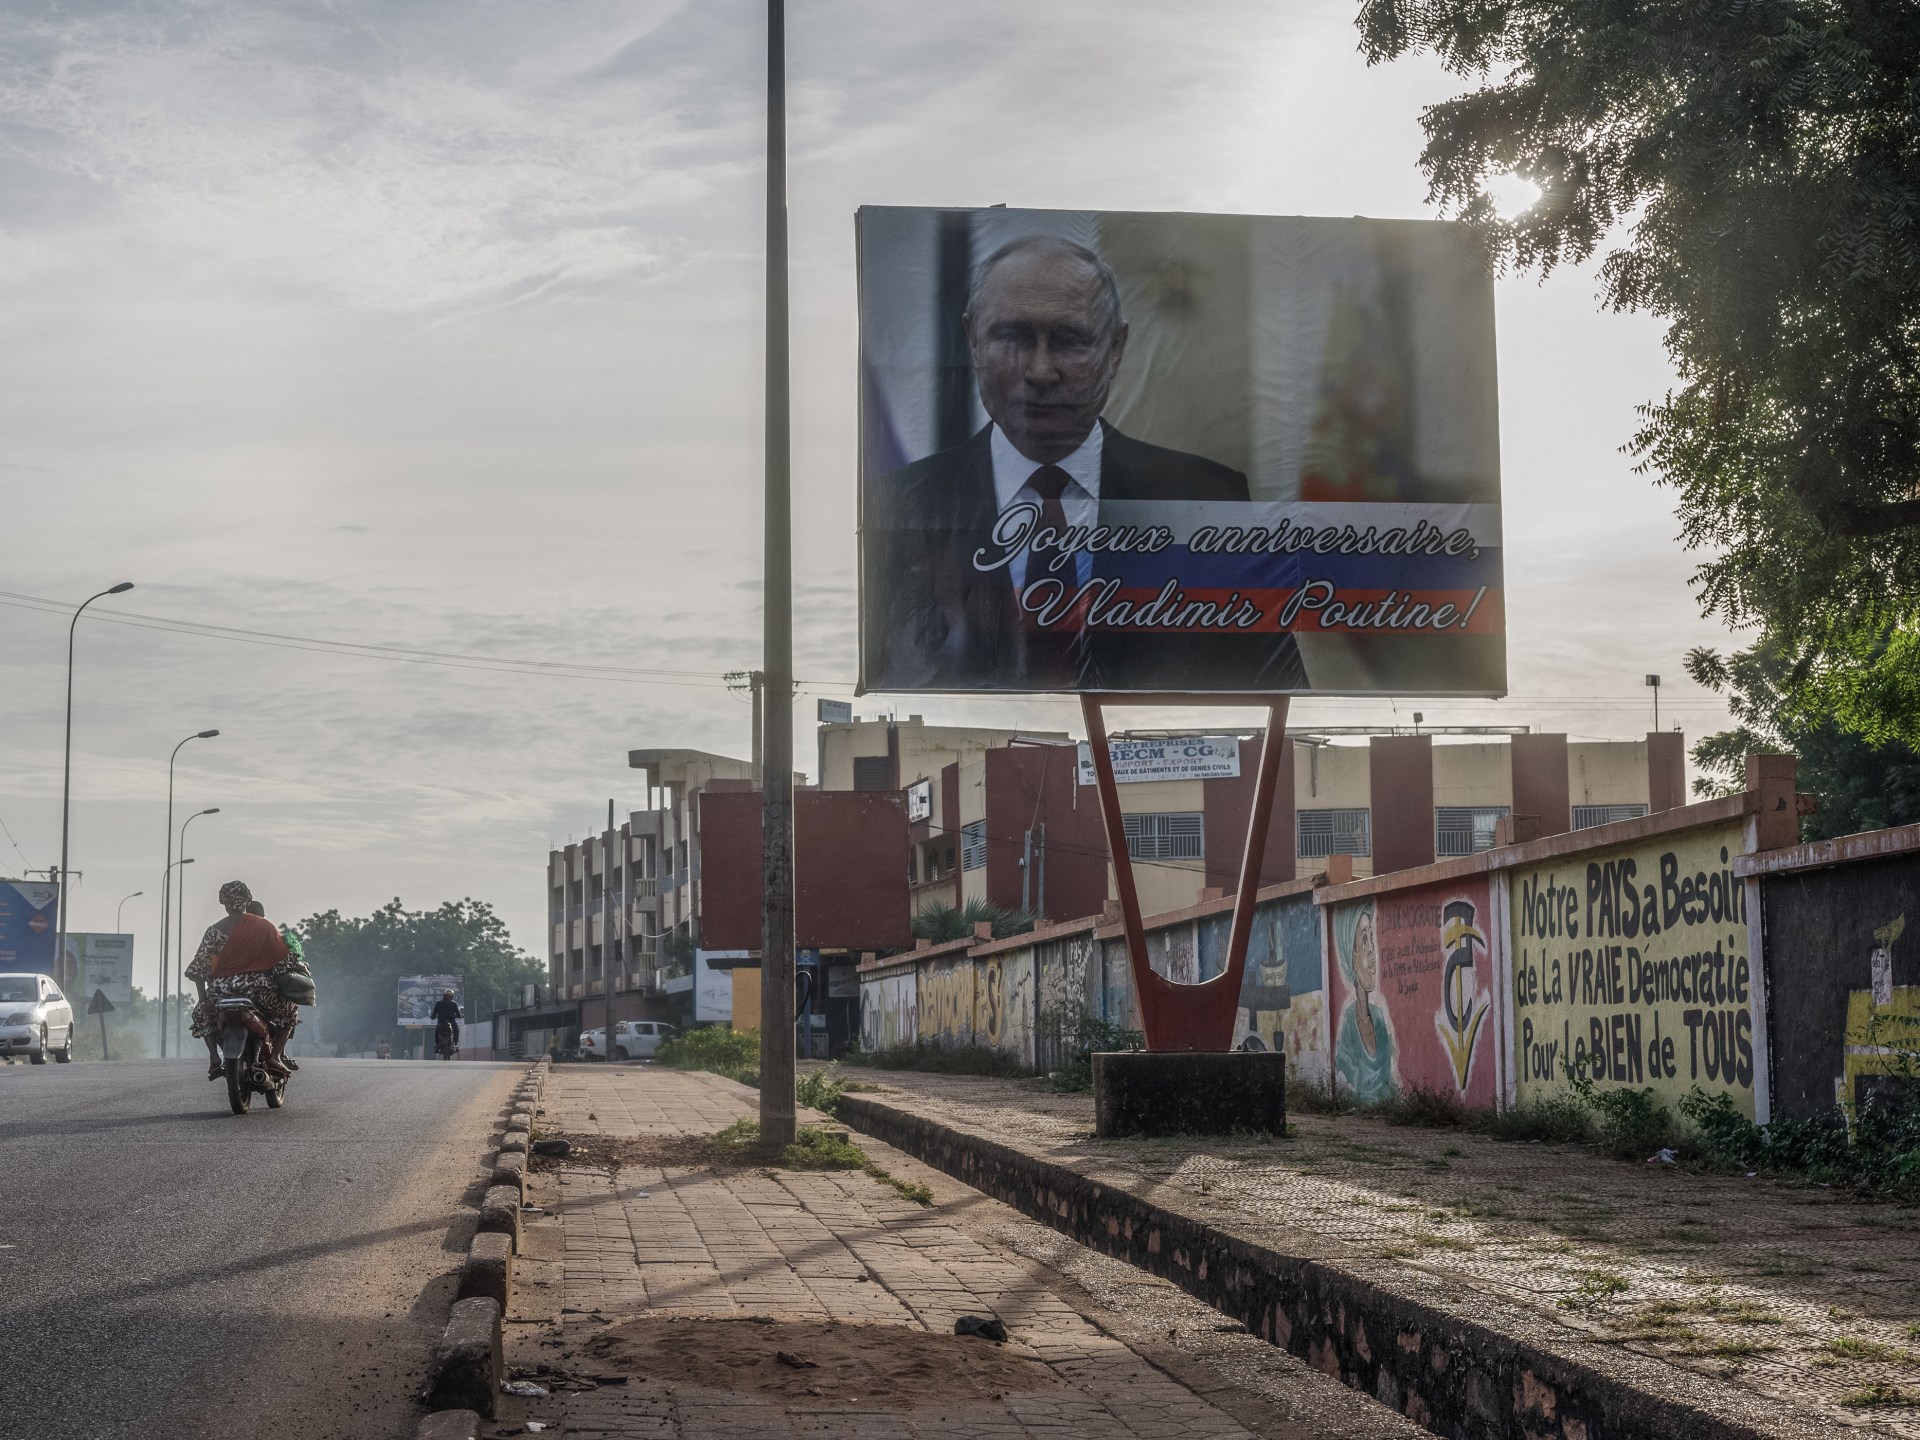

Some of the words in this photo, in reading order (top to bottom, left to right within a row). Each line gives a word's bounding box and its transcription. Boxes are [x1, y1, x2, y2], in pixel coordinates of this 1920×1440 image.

[973, 503, 1175, 572] Joyeux
[1188, 518, 1480, 560] anniversaire,
[1022, 577, 1262, 628] Vladimir
[1279, 578, 1488, 628] Poutine!
[1114, 739, 1206, 750] ENTREPRISES
[1115, 759, 1154, 769] IMPORT
[1163, 758, 1204, 766] EXPORT
[1212, 763, 1231, 771] CIVILS
[1521, 873, 1579, 939] Notre
[1586, 858, 1641, 939] PAYS
[1642, 884, 1661, 938] a
[1660, 846, 1748, 931] Besoin
[1517, 949, 1538, 1008] de
[1542, 948, 1562, 1005] La
[1568, 945, 1625, 1005] VRAIE
[1626, 934, 1750, 1007] Démocratie
[1522, 1017, 1558, 1083] Pour
[1564, 1020, 1587, 1080] Le
[1590, 1013, 1644, 1083] BIEN
[1648, 1010, 1677, 1080] de
[1683, 1008, 1754, 1089] TOUS
